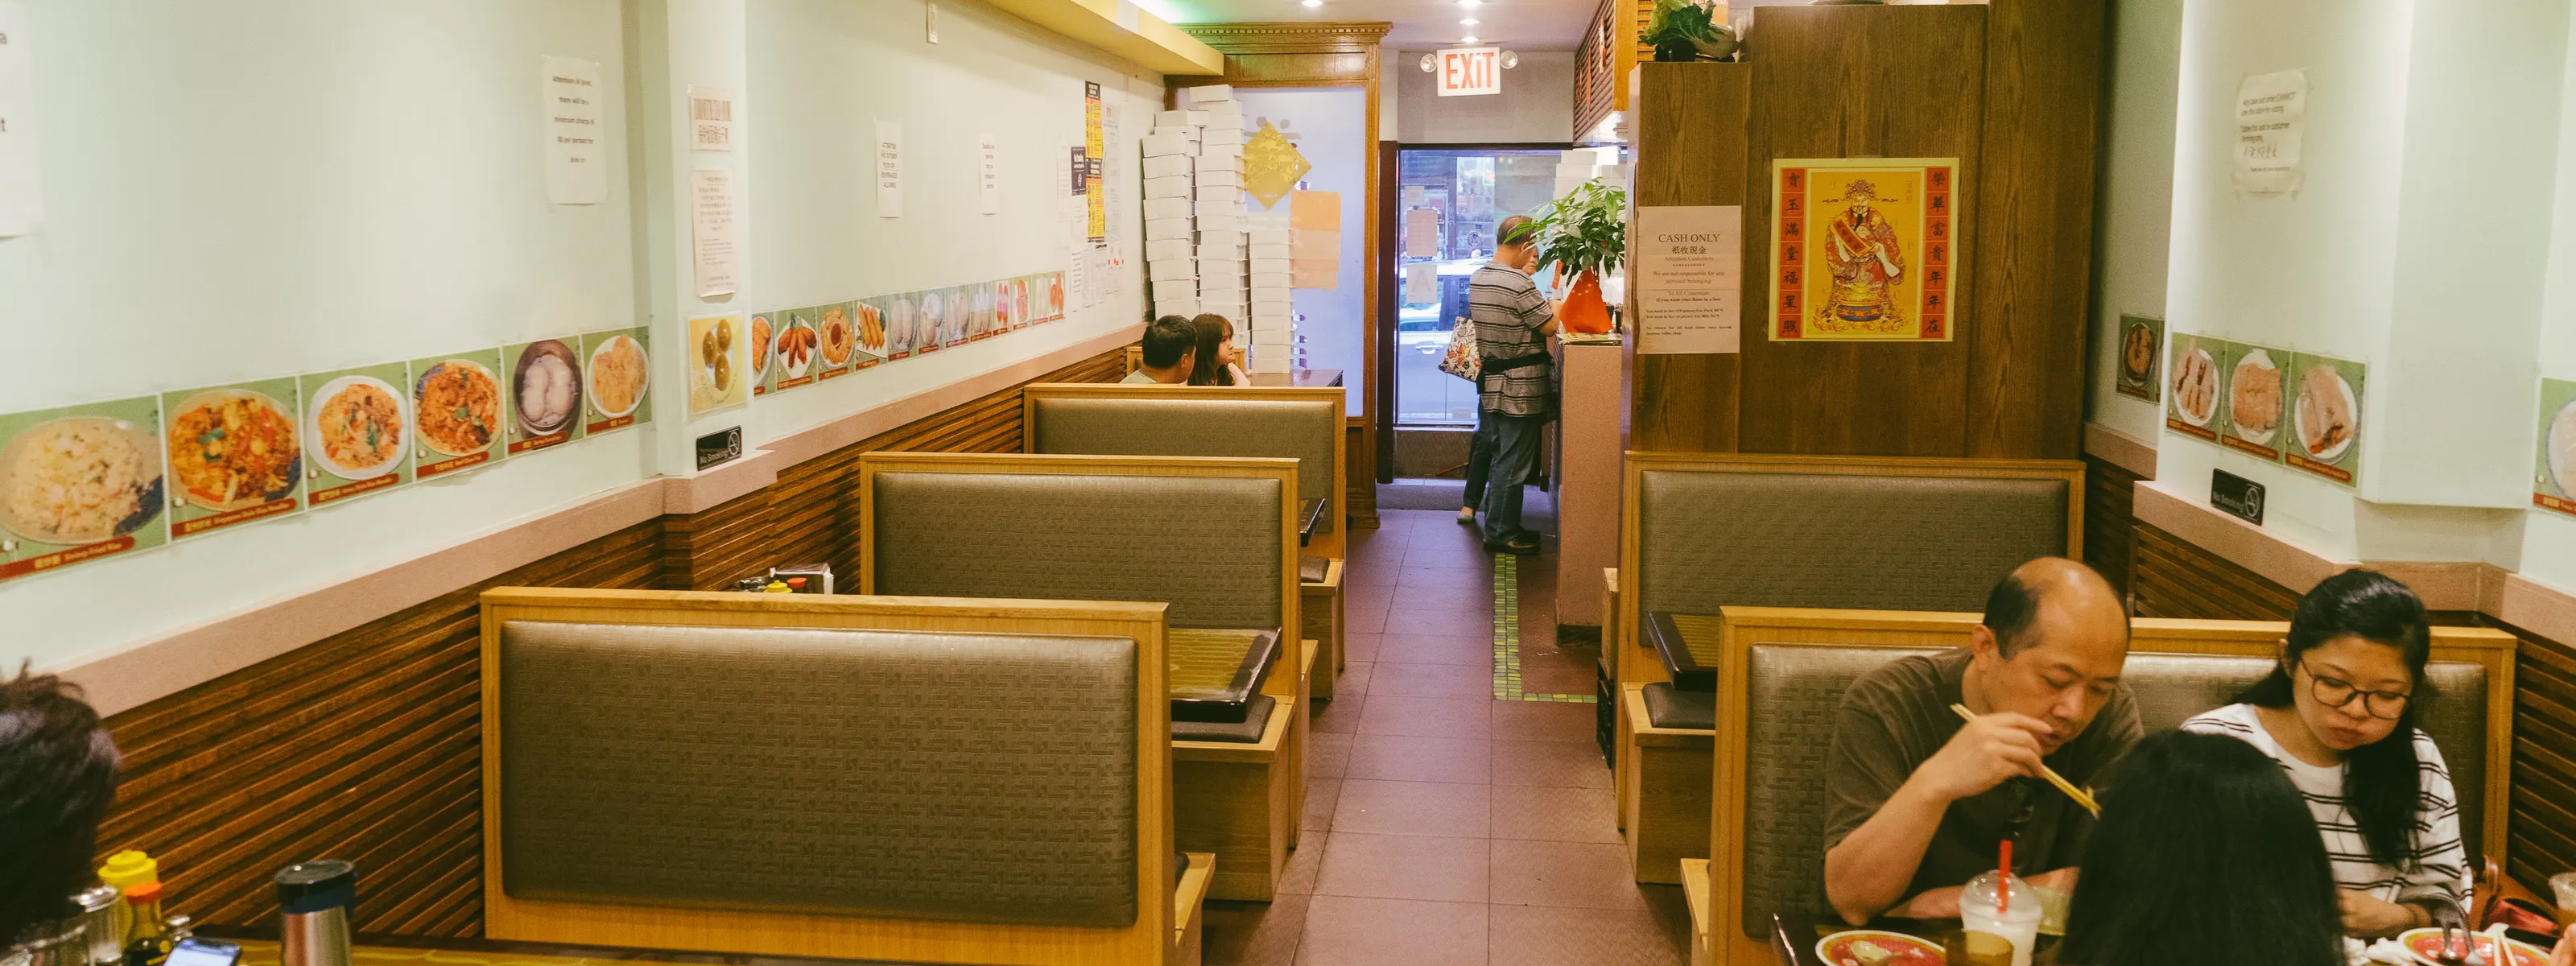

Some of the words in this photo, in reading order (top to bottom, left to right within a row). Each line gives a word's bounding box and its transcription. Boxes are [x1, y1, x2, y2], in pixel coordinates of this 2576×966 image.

[1445, 52, 1494, 89] EXIT
[1658, 233, 1687, 243] CASH
[1690, 233, 1720, 243] ONLY
